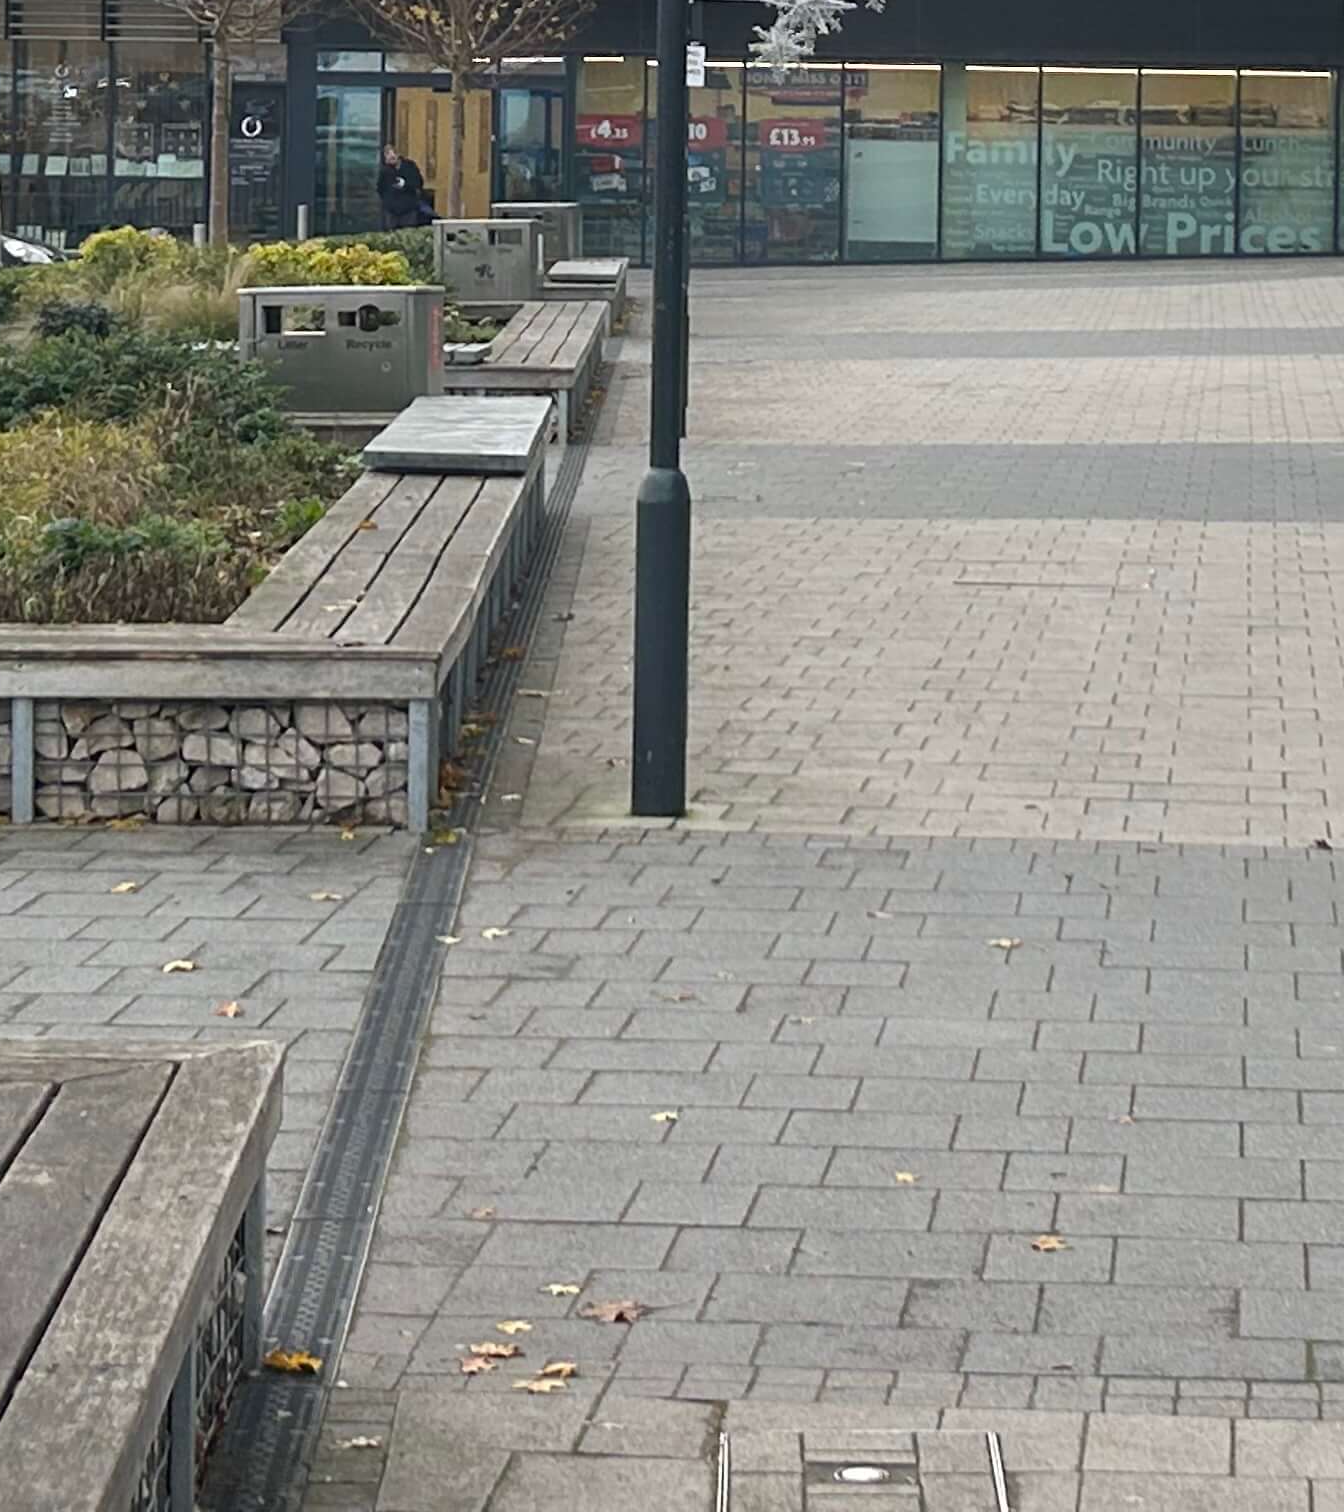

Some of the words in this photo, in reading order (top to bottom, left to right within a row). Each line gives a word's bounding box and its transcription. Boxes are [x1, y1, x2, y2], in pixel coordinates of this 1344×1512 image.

[943, 130, 1078, 178] Family
[1097, 158, 1170, 192] Right
[1179, 166, 1217, 194] up
[1223, 166, 1293, 194] your
[975, 183, 1086, 212] Everyday
[1141, 191, 1196, 209] Brands
[1041, 210, 1150, 255] Low
[1166, 211, 1322, 255] Prices
